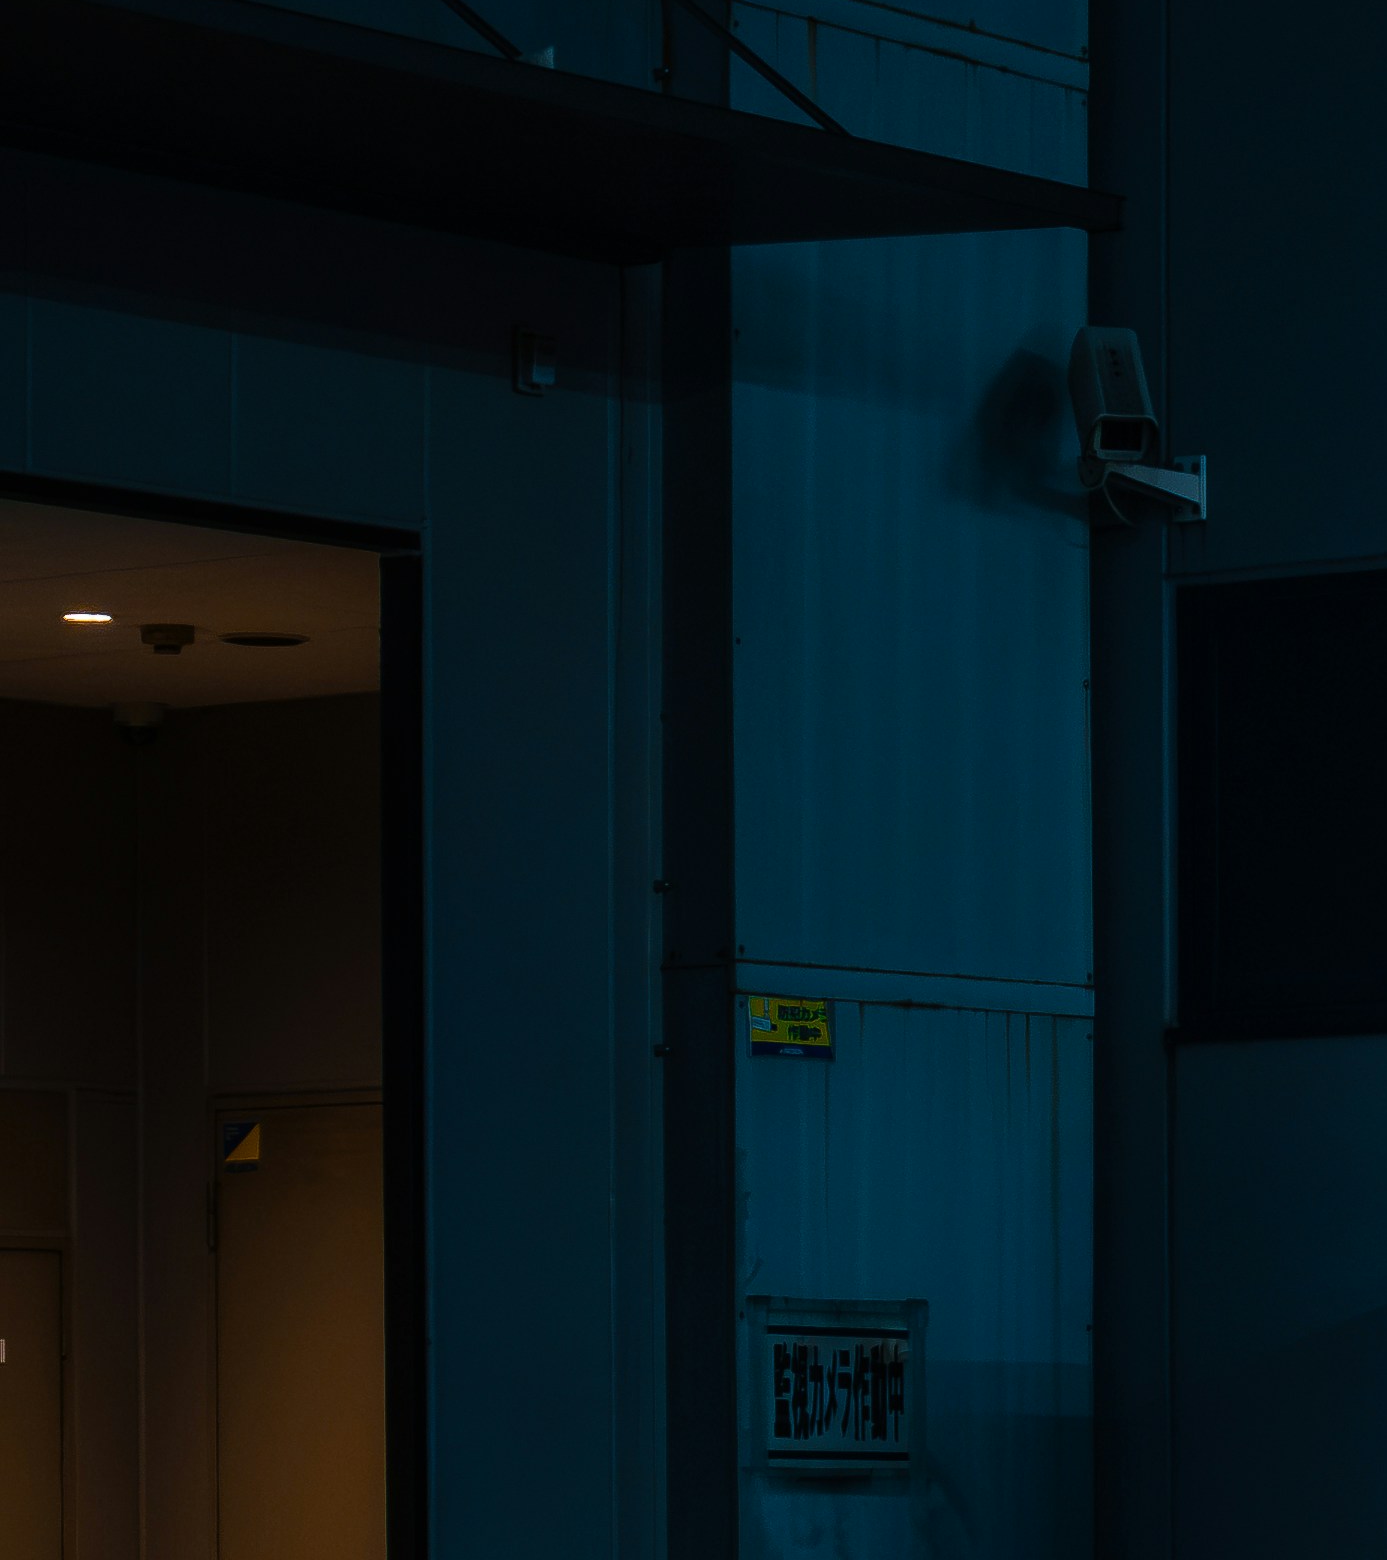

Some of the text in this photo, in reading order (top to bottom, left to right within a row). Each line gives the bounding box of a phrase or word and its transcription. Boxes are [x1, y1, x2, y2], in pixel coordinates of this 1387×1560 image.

[773, 1341, 905, 1443] 監視カメラ作動中
